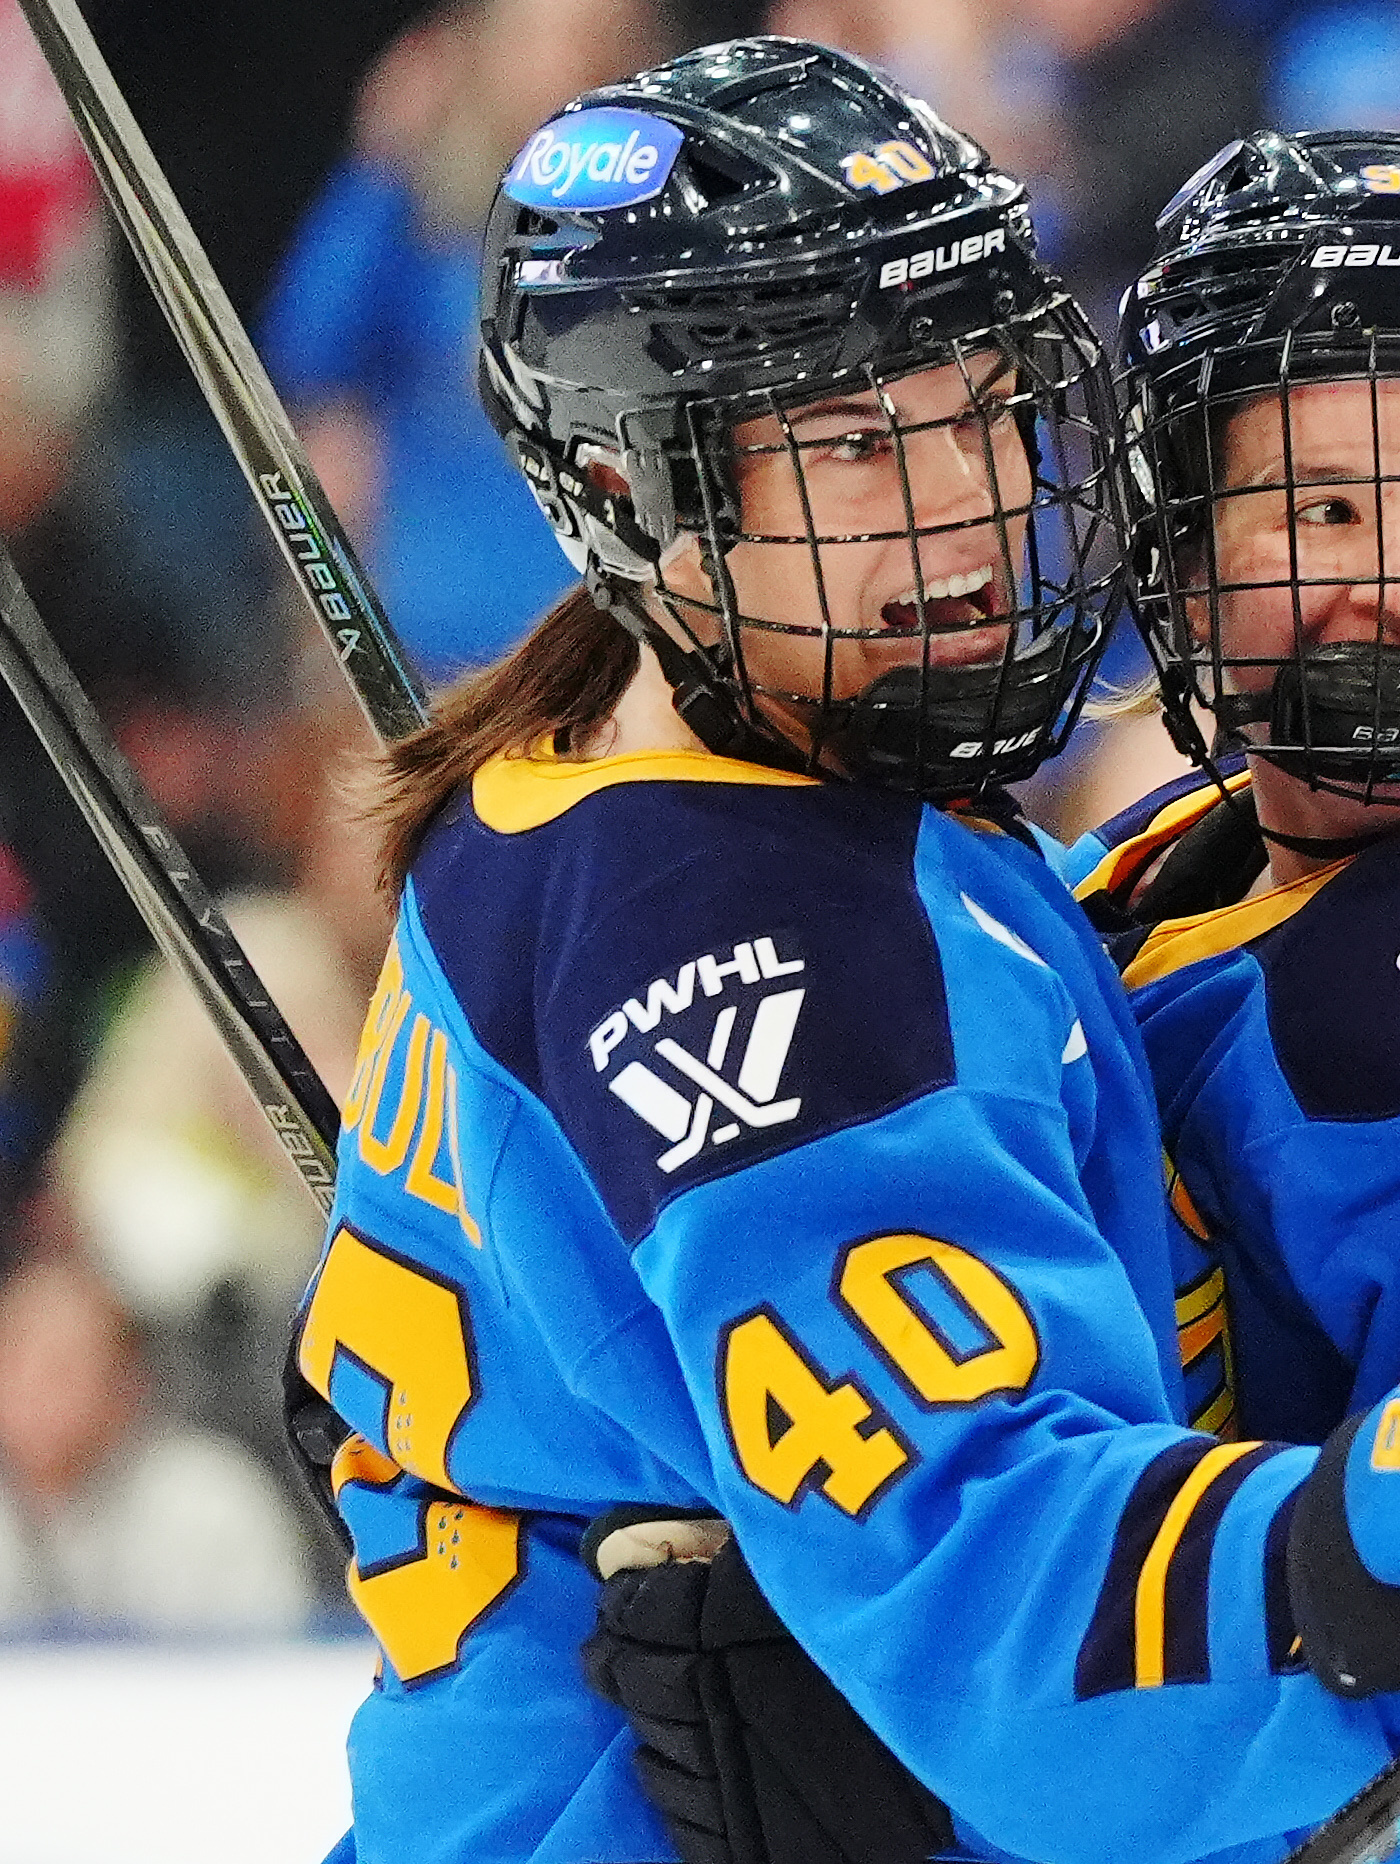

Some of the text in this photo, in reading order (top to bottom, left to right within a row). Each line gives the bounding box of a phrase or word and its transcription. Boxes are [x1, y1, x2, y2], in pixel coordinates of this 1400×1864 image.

[516, 129, 659, 198] Royale
[843, 138, 936, 197] 40
[879, 228, 1006, 290] BAUER
[258, 470, 352, 622] BAUER
[590, 936, 805, 1072] PWHL
[716, 1227, 1041, 1521] 40
